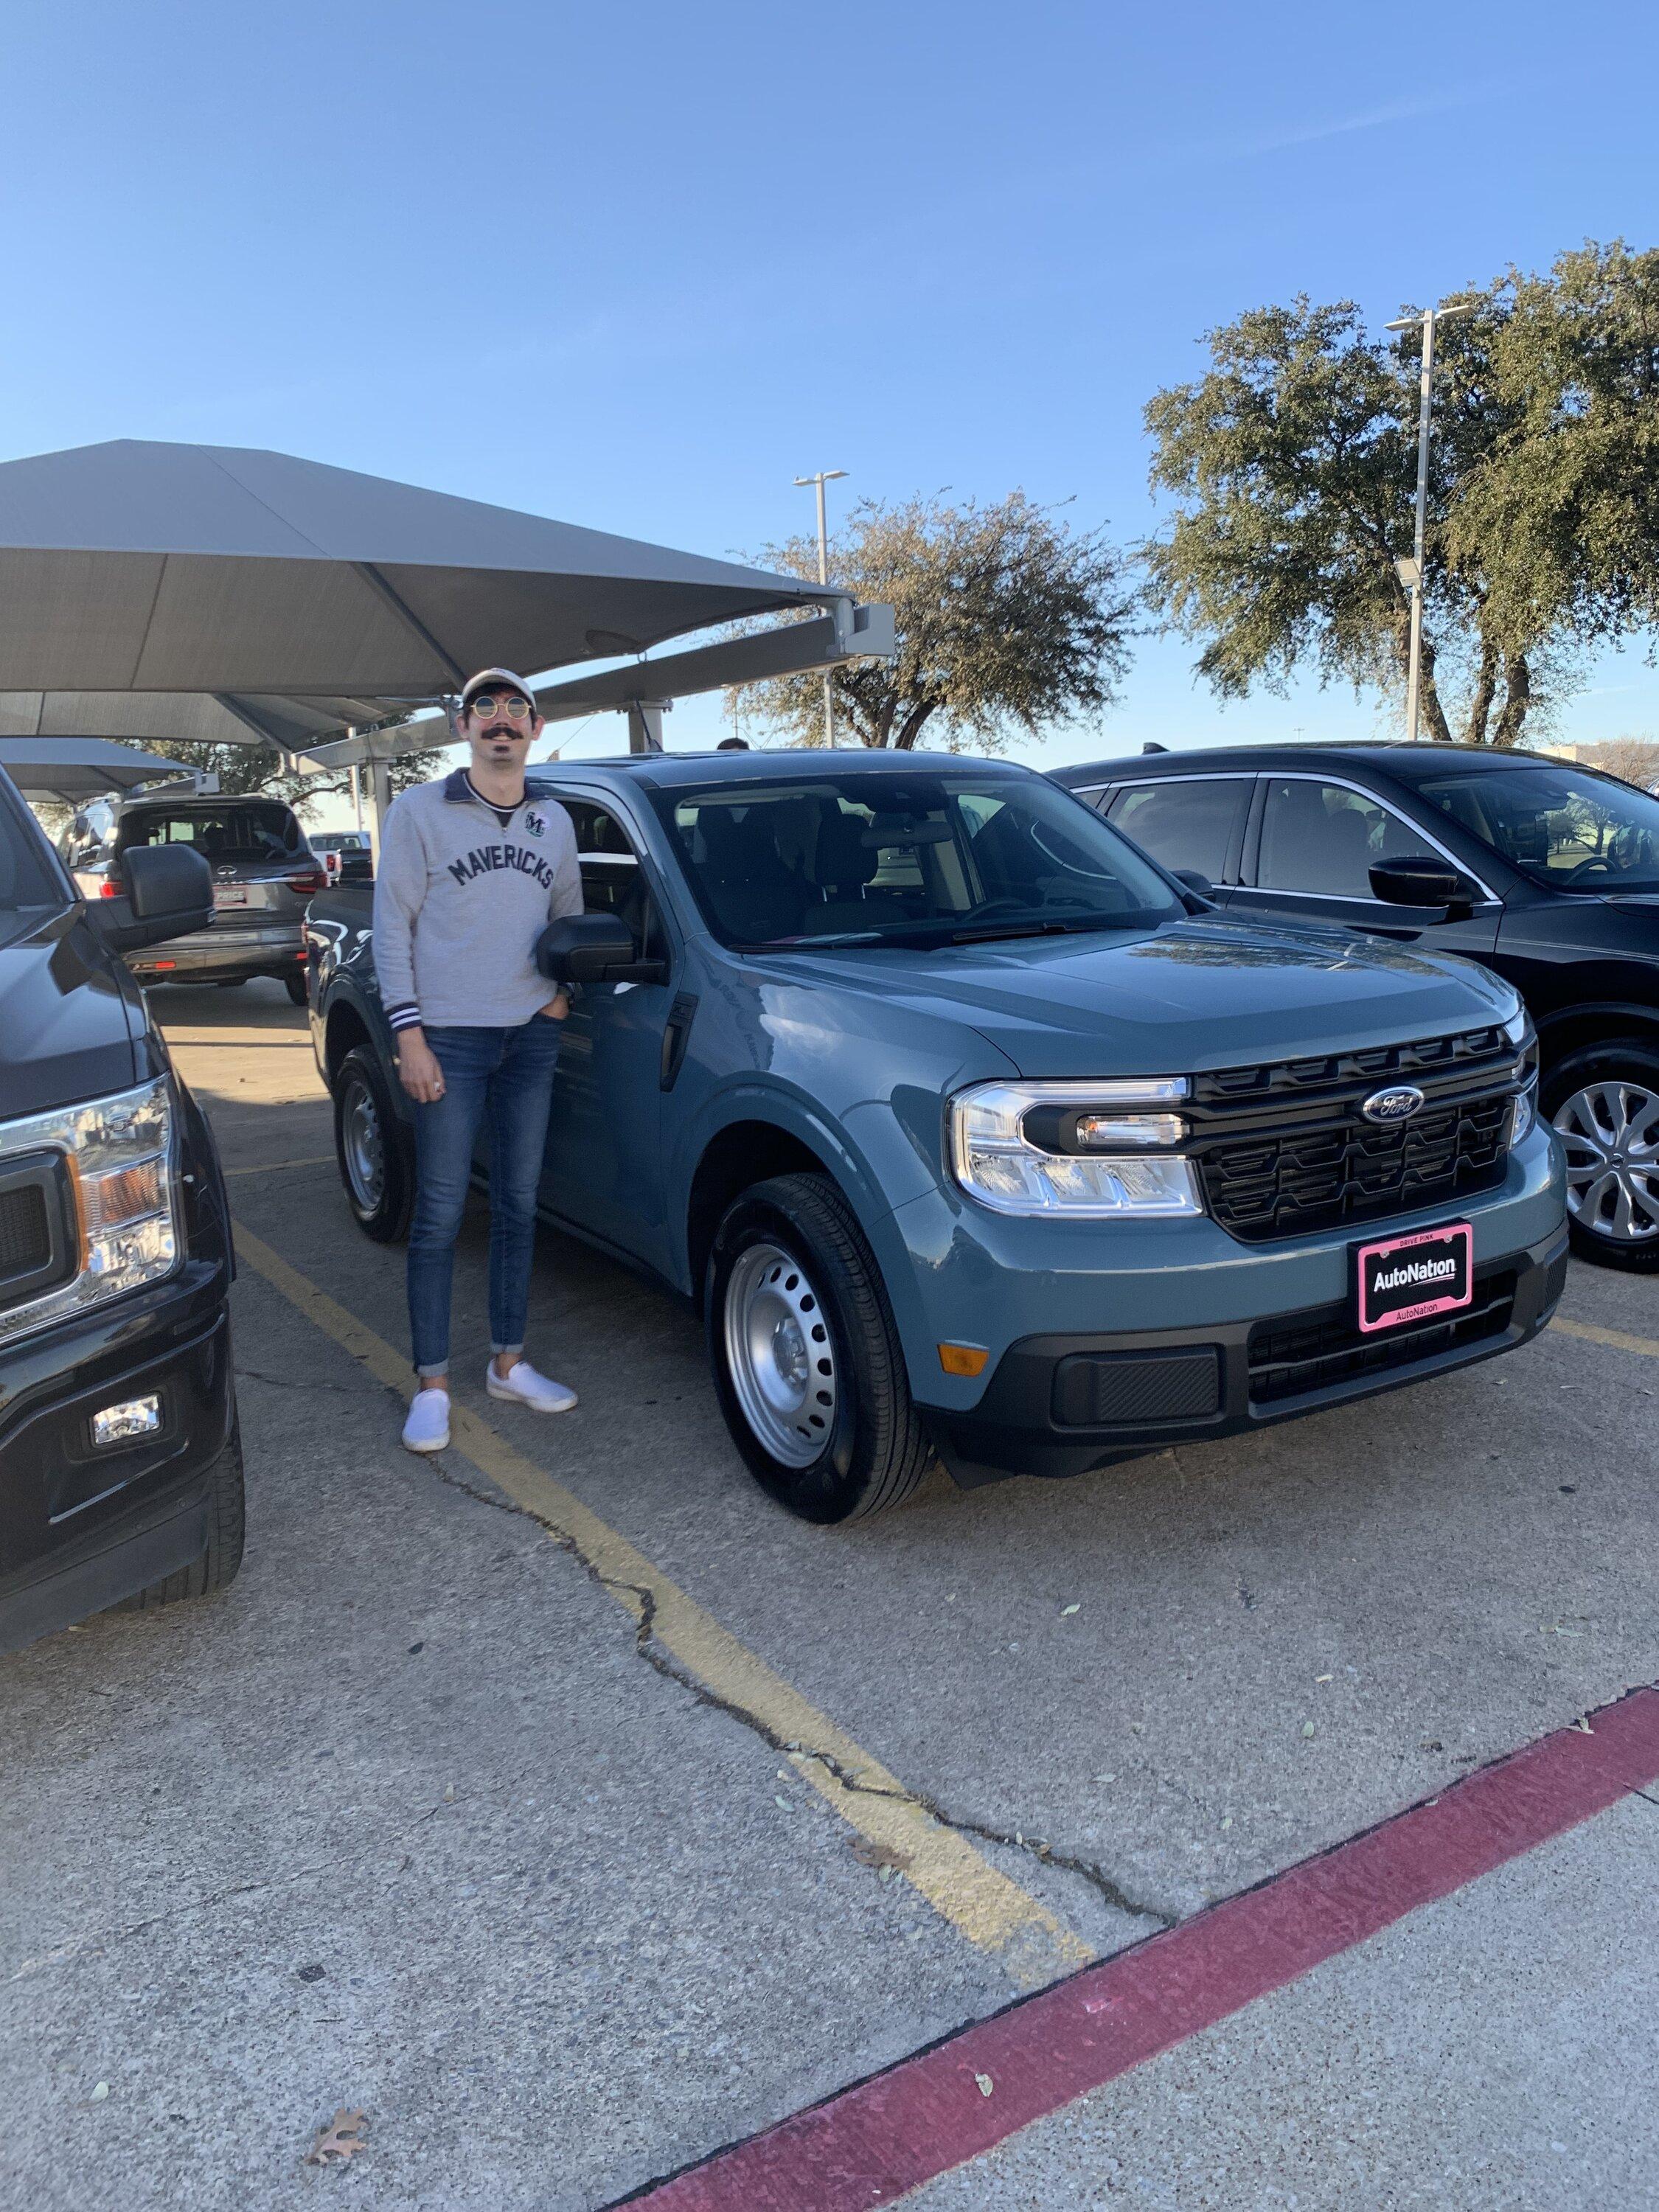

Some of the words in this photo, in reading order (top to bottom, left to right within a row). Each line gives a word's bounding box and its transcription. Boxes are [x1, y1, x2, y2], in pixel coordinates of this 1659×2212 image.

[448, 844, 554, 890] MAVERICKS
[1380, 1095, 1413, 1116] Ford
[1400, 1237, 1418, 1248] DRIVE
[1419, 1234, 1434, 1243] PINK
[1373, 1258, 1455, 1293] AutoNation
[1396, 1303, 1438, 1322] AutoNation
